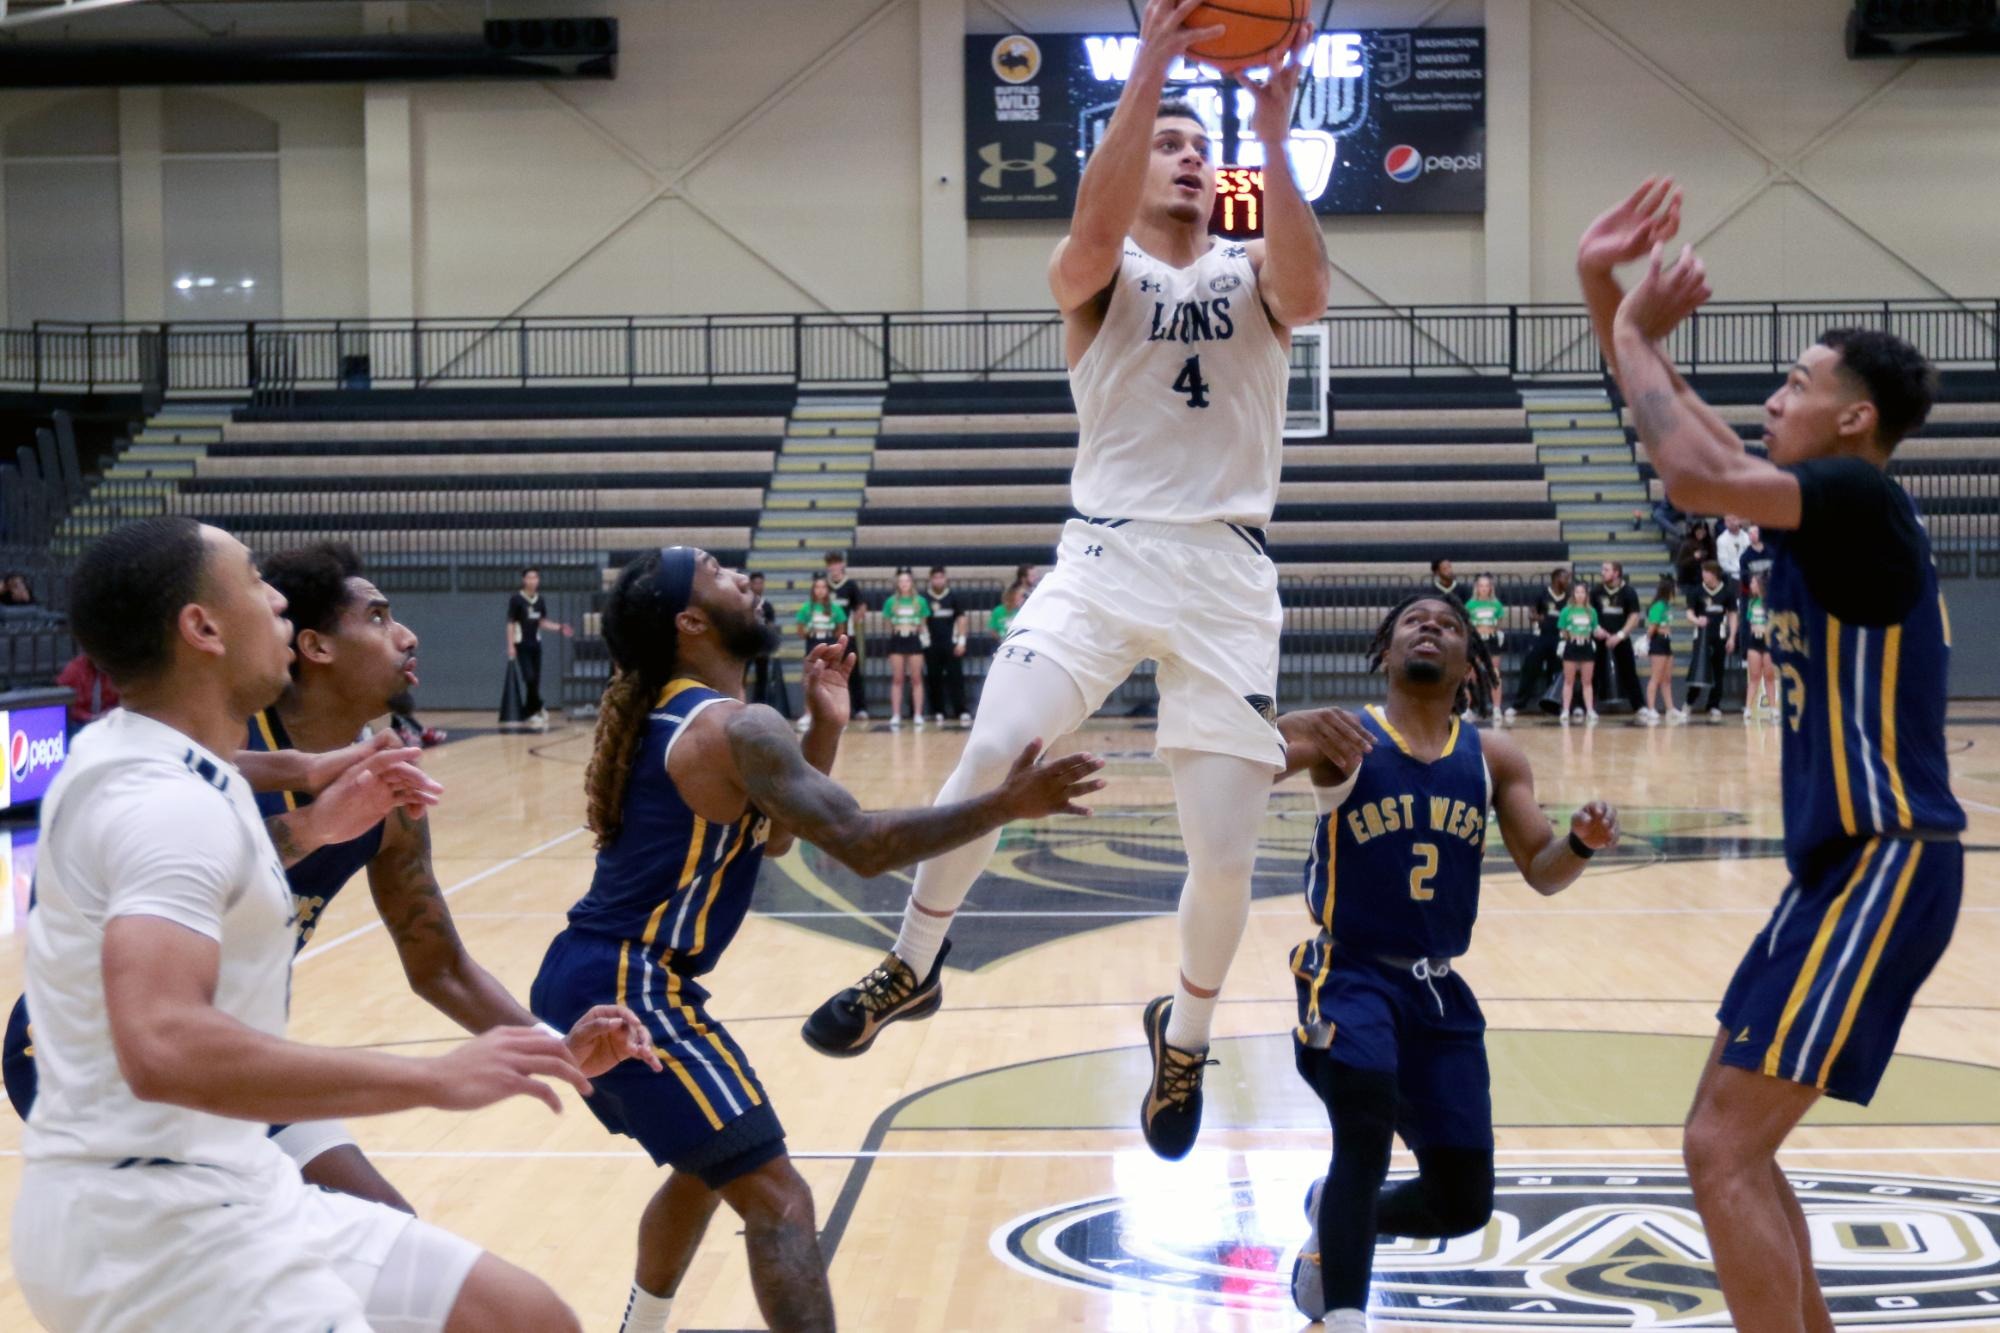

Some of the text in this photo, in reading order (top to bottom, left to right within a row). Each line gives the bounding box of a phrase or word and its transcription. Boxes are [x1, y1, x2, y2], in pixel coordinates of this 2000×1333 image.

[1415, 38, 1479, 48] WASHINGTON
[1415, 53, 1470, 64] UNIVERSITY
[1415, 69, 1482, 79] ORTHOPEDICS
[995, 95, 1040, 109] WILD
[996, 110, 1040, 121] WINGS
[1424, 151, 1483, 174] pepsi
[1224, 192, 1257, 231] 17
[1149, 297, 1234, 344] LIONS
[1172, 354, 1210, 408] 4
[29, 730, 63, 773] pepsi
[1347, 794, 1414, 845] EAST
[1410, 842, 1439, 901] 2
